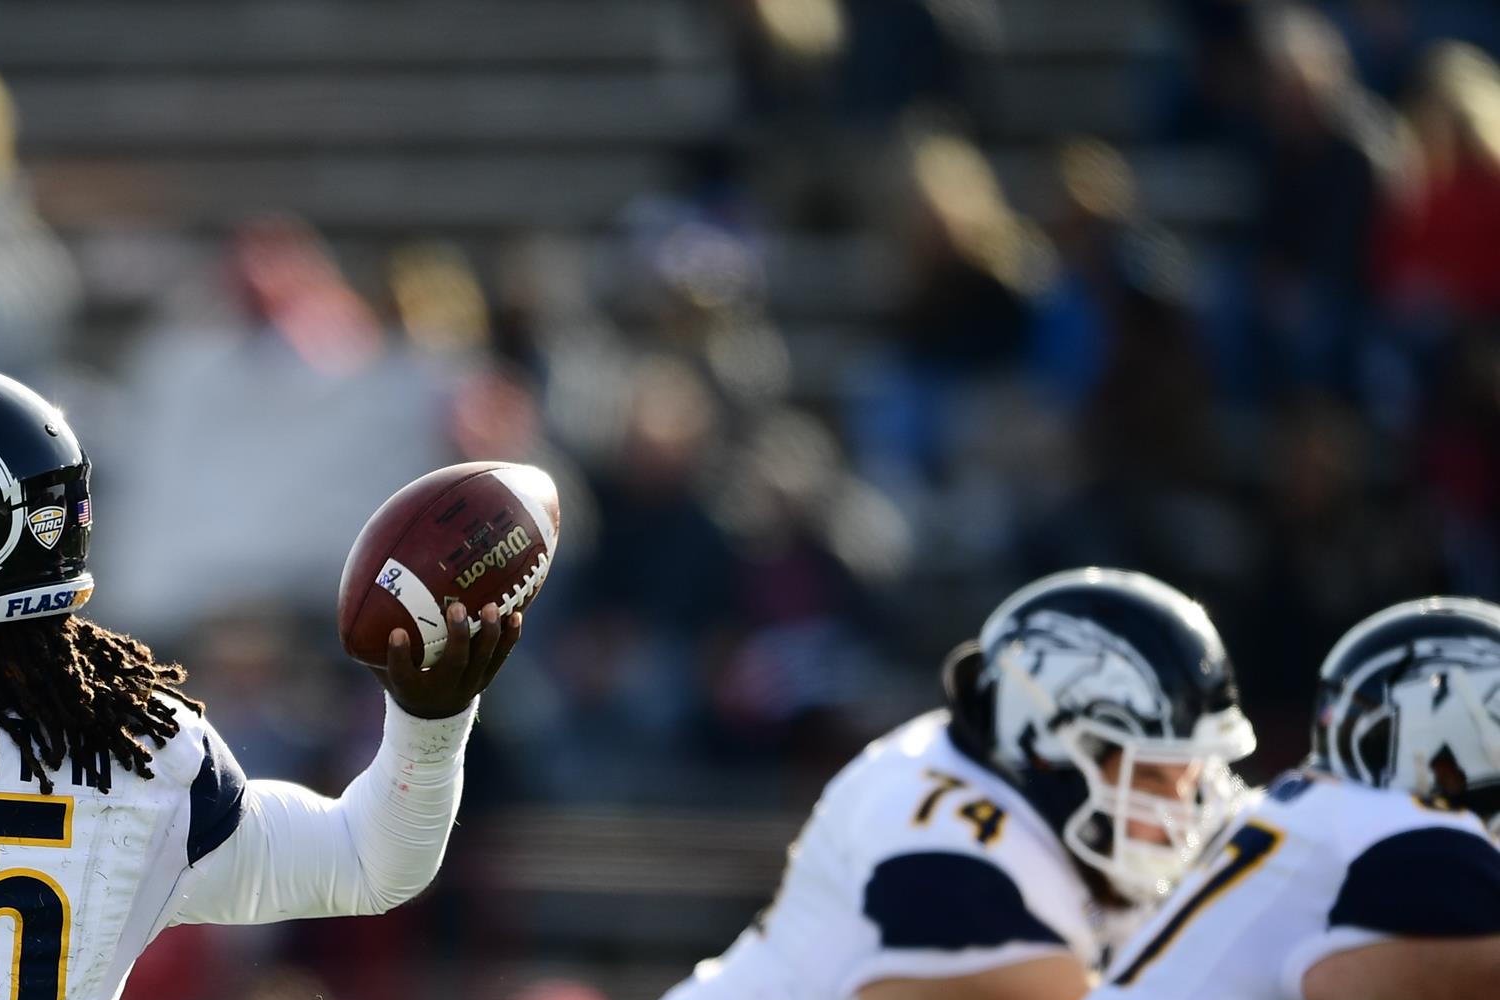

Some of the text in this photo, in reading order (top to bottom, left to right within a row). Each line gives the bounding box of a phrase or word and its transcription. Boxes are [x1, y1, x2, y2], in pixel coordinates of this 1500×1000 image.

[33, 518, 64, 535] MAC
[454, 525, 532, 590] Wilson
[910, 766, 1006, 846] 74
